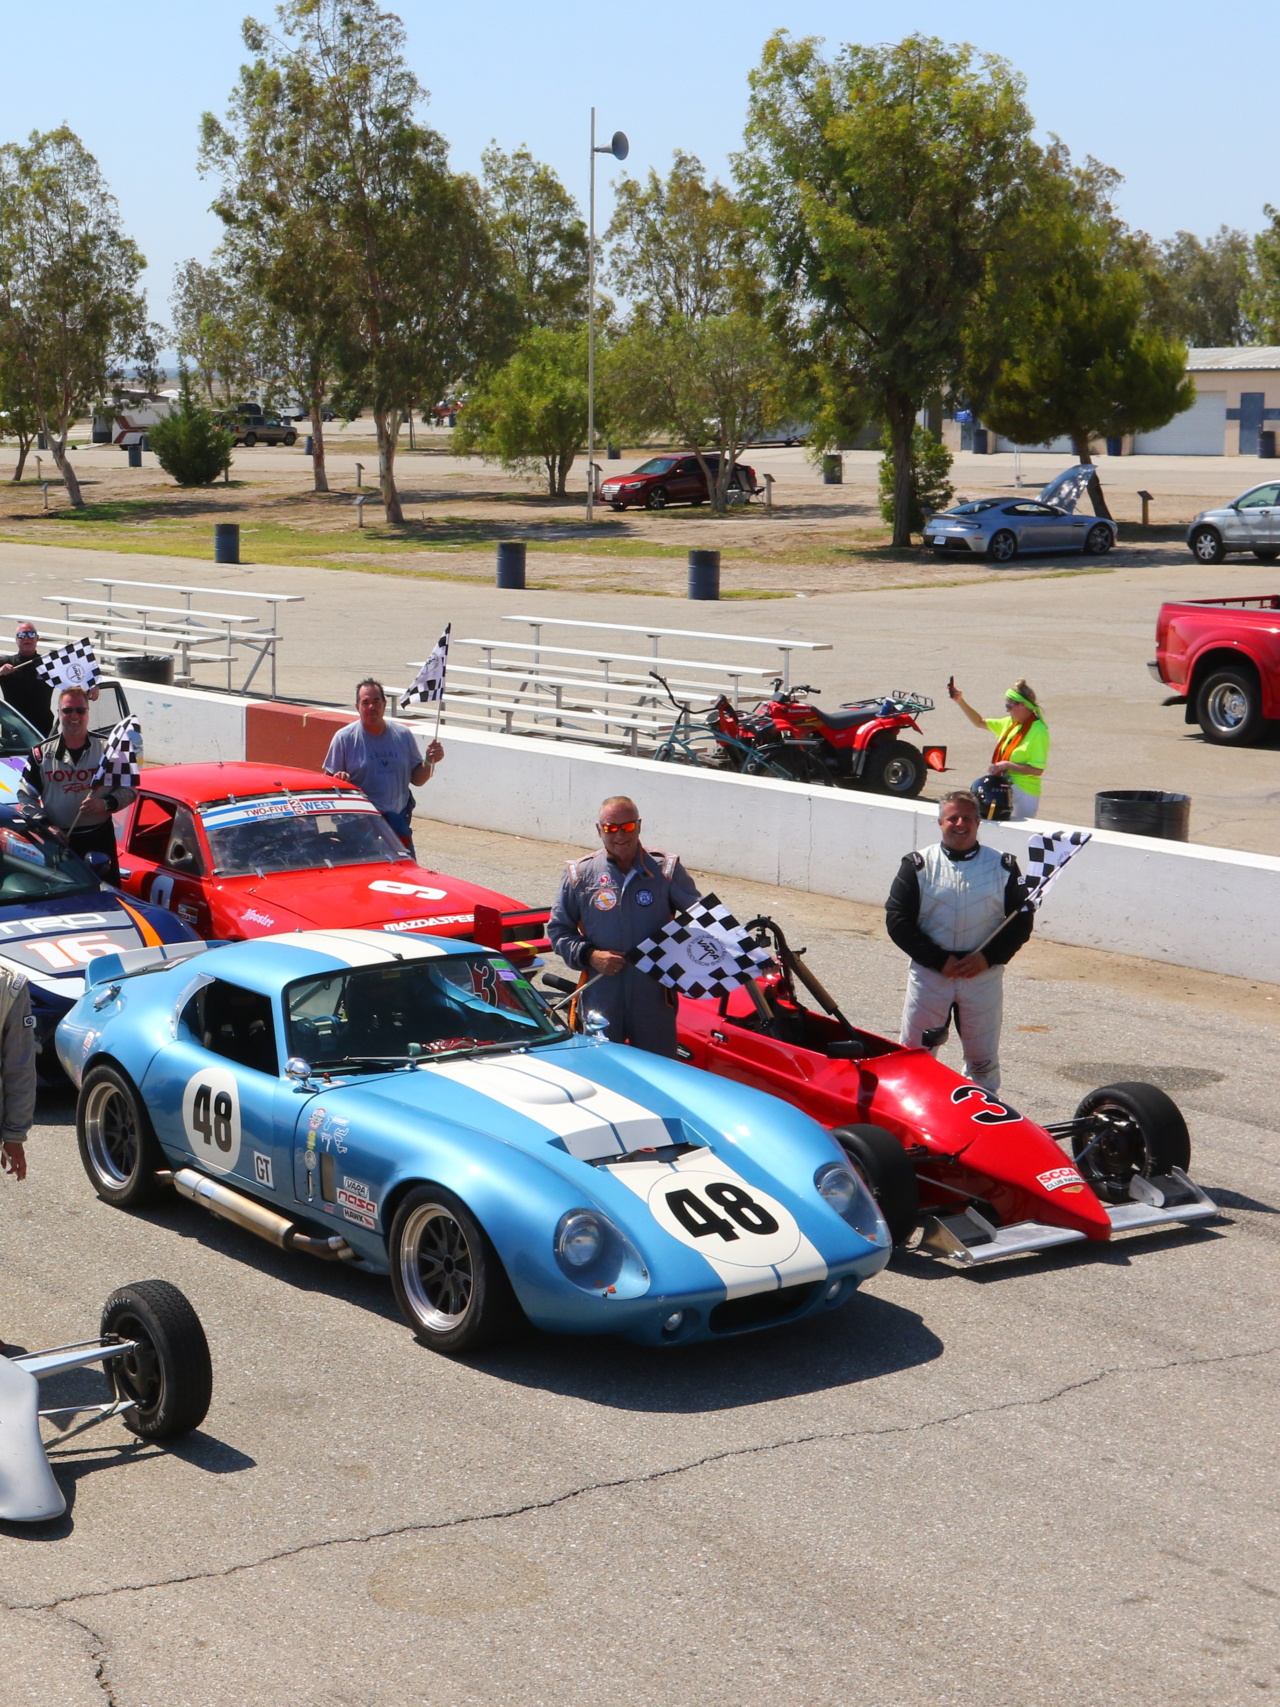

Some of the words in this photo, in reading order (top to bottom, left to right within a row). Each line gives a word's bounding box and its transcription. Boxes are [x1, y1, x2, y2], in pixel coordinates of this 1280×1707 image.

[45, 768, 97, 783] TOYOT
[243, 804, 291, 817] TWO-FIVE
[301, 801, 336, 811] WEST
[368, 879, 448, 900] 9
[382, 913, 476, 932] MAZDASPEE
[24, 934, 129, 970] 16
[951, 1085, 1024, 1125] 3
[193, 1083, 233, 1153] 48
[255, 1155, 271, 1184] GT
[1039, 1168, 1077, 1184] SCCA
[346, 1180, 367, 1196] VARA
[1046, 1179, 1064, 1190] CLUB
[338, 1191, 376, 1214] nasa
[665, 1182, 780, 1243] 48
[344, 1208, 365, 1223] HAWK
